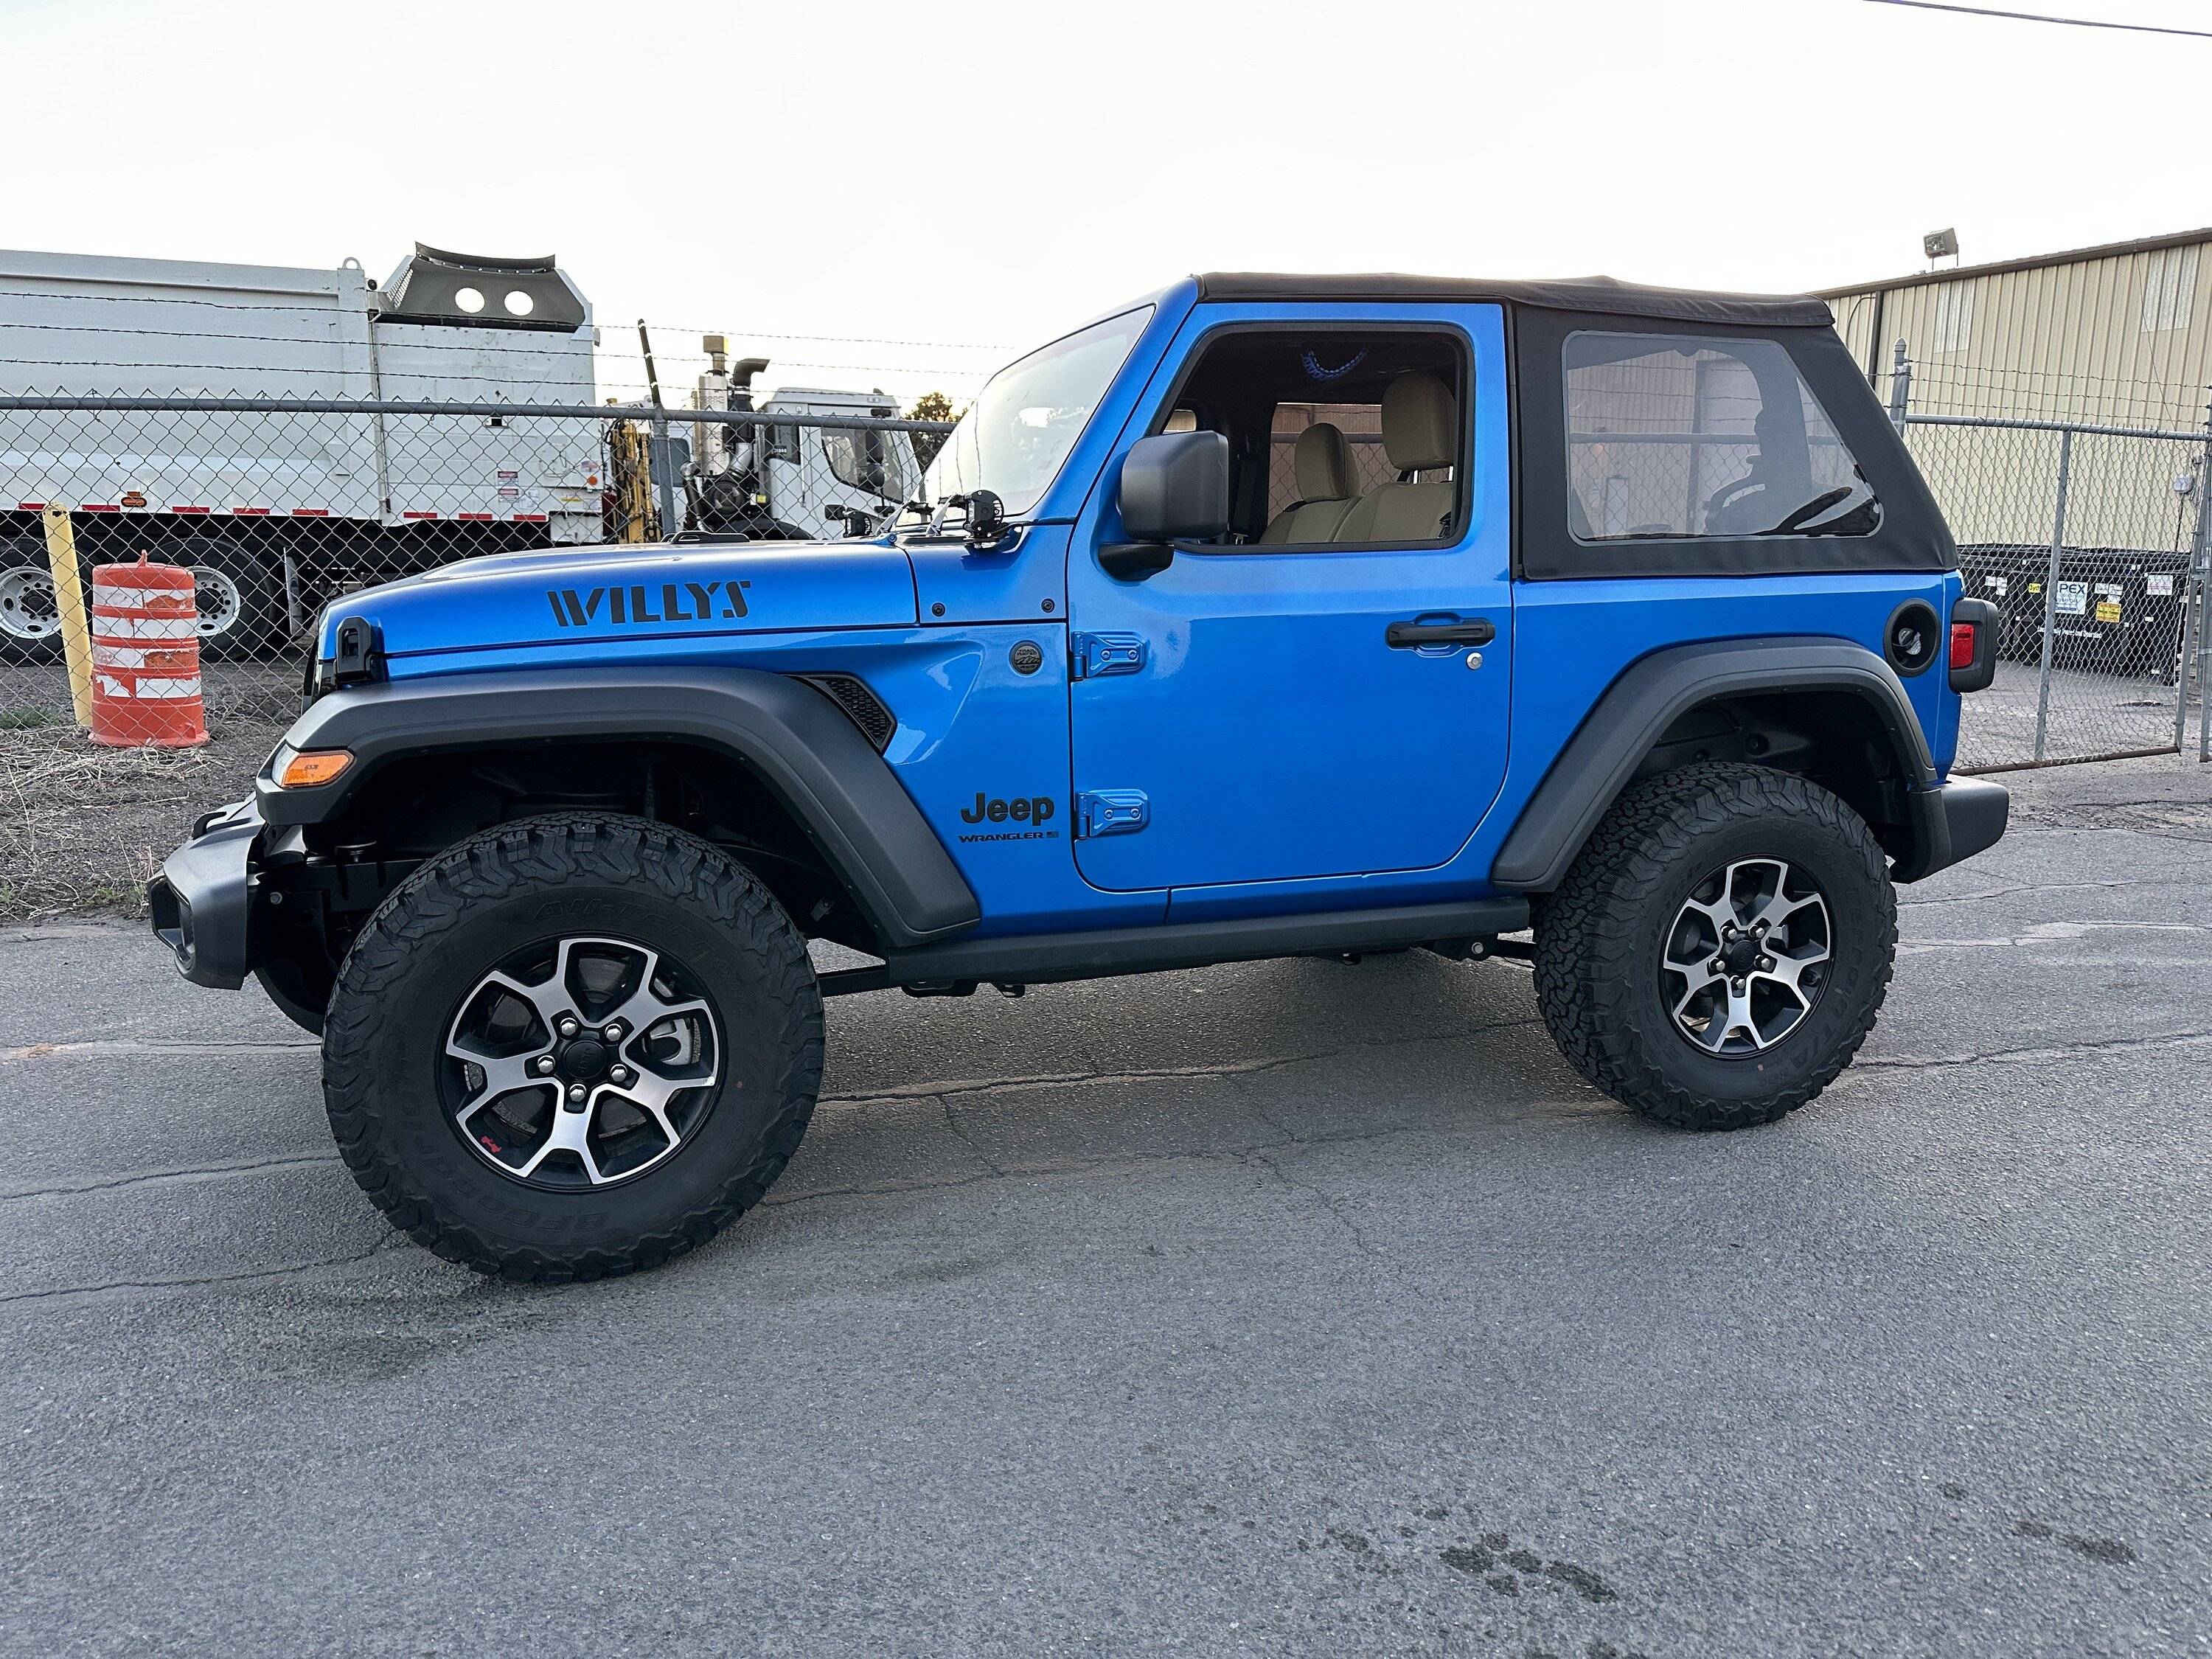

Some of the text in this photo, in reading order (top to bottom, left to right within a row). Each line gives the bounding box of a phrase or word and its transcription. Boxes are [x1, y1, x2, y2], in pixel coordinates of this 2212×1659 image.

[2059, 583, 2085, 594] PEX
[547, 580, 751, 627] WILLYS
[961, 793, 1054, 826] Jeep
[959, 831, 1044, 843] WRANGLER
